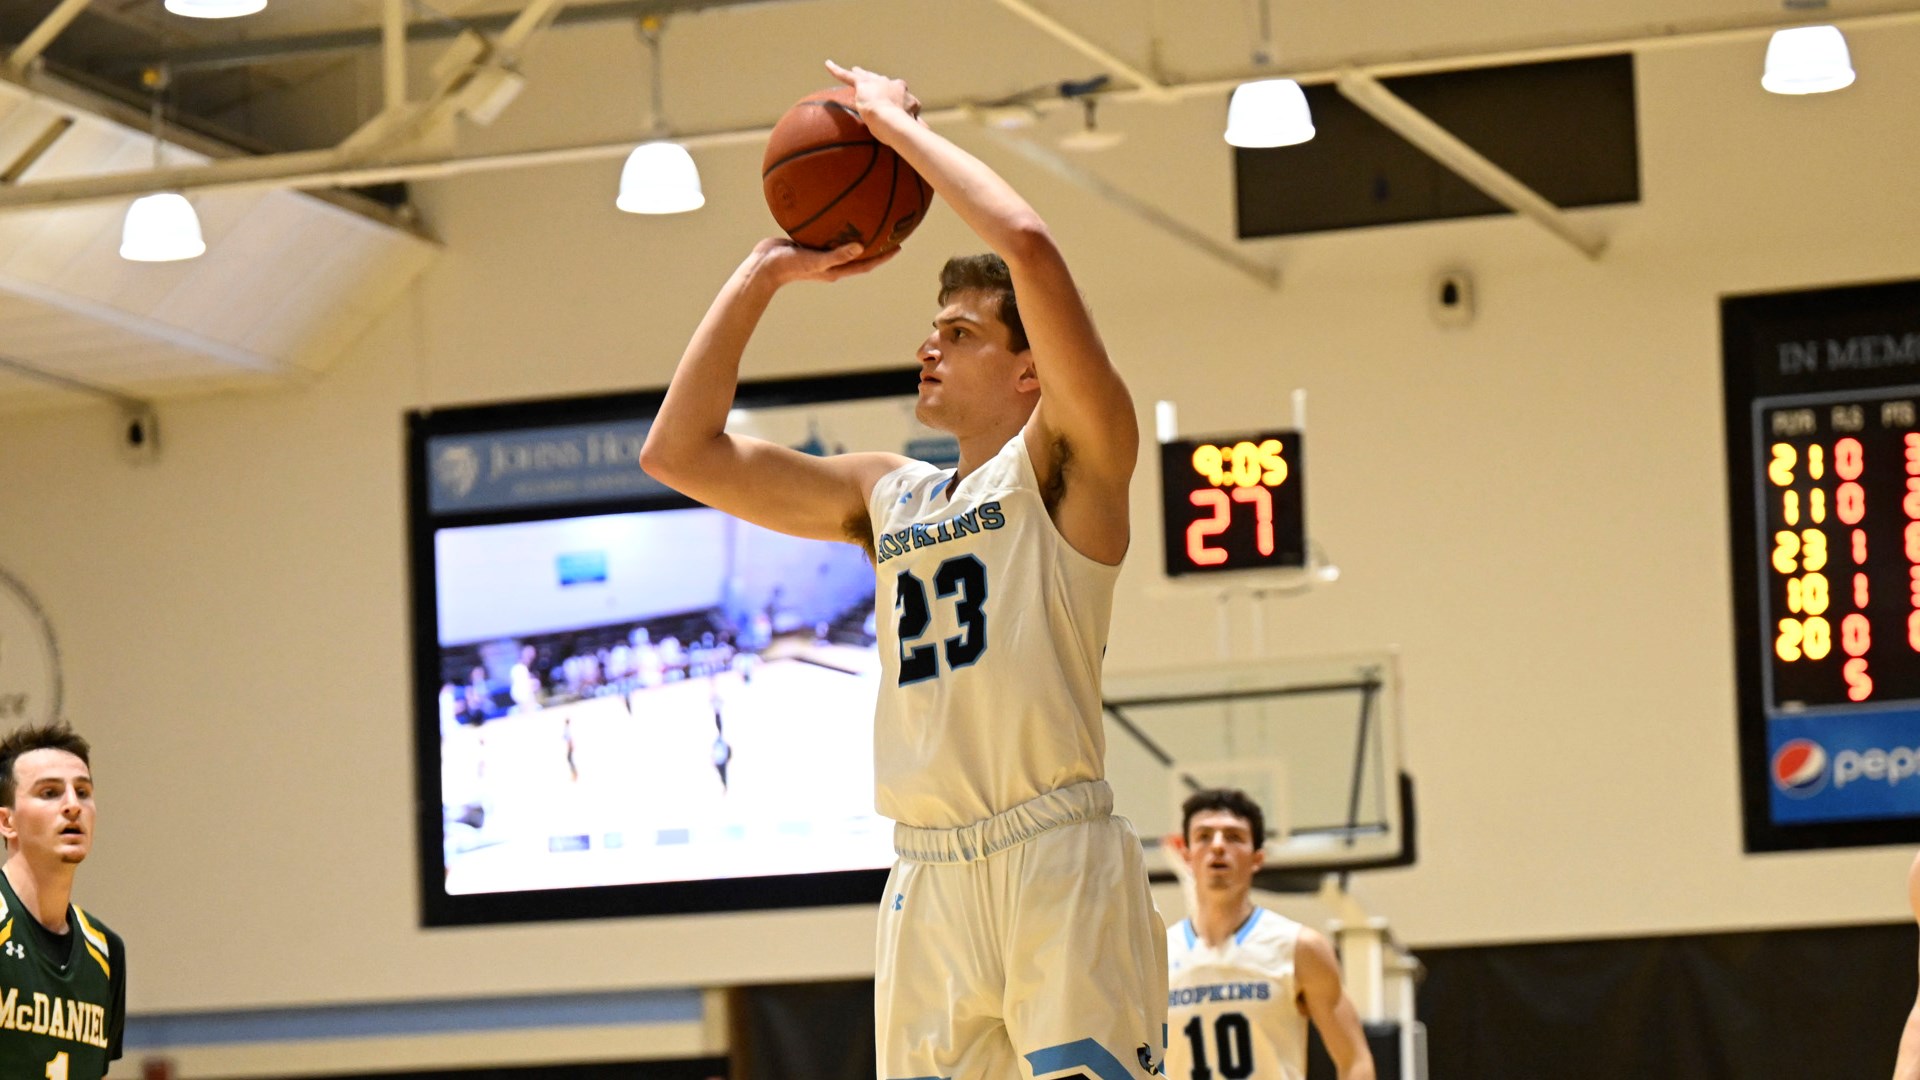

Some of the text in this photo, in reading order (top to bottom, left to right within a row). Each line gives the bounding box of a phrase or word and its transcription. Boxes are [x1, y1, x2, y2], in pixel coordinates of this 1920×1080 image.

[1826, 332, 1920, 372] MEM
[1192, 439, 1288, 487] 9:05
[1768, 442, 1824, 487] 21
[1834, 437, 1864, 481] 0
[1186, 486, 1274, 566] 27
[1783, 487, 1826, 526] 11
[1836, 481, 1865, 525] 0
[877, 501, 1006, 563] HOPKINS
[1772, 528, 1828, 574] 23
[1852, 528, 1867, 565] 1
[1787, 572, 1829, 616] 10
[1853, 572, 1869, 609] 1
[895, 552, 988, 688] 23
[1775, 615, 1831, 662] 20
[1841, 613, 1871, 656] 0
[1833, 746, 1920, 789] pep
[0, 985, 108, 1049] McDANIEL
[1184, 1011, 1255, 1080] 10
